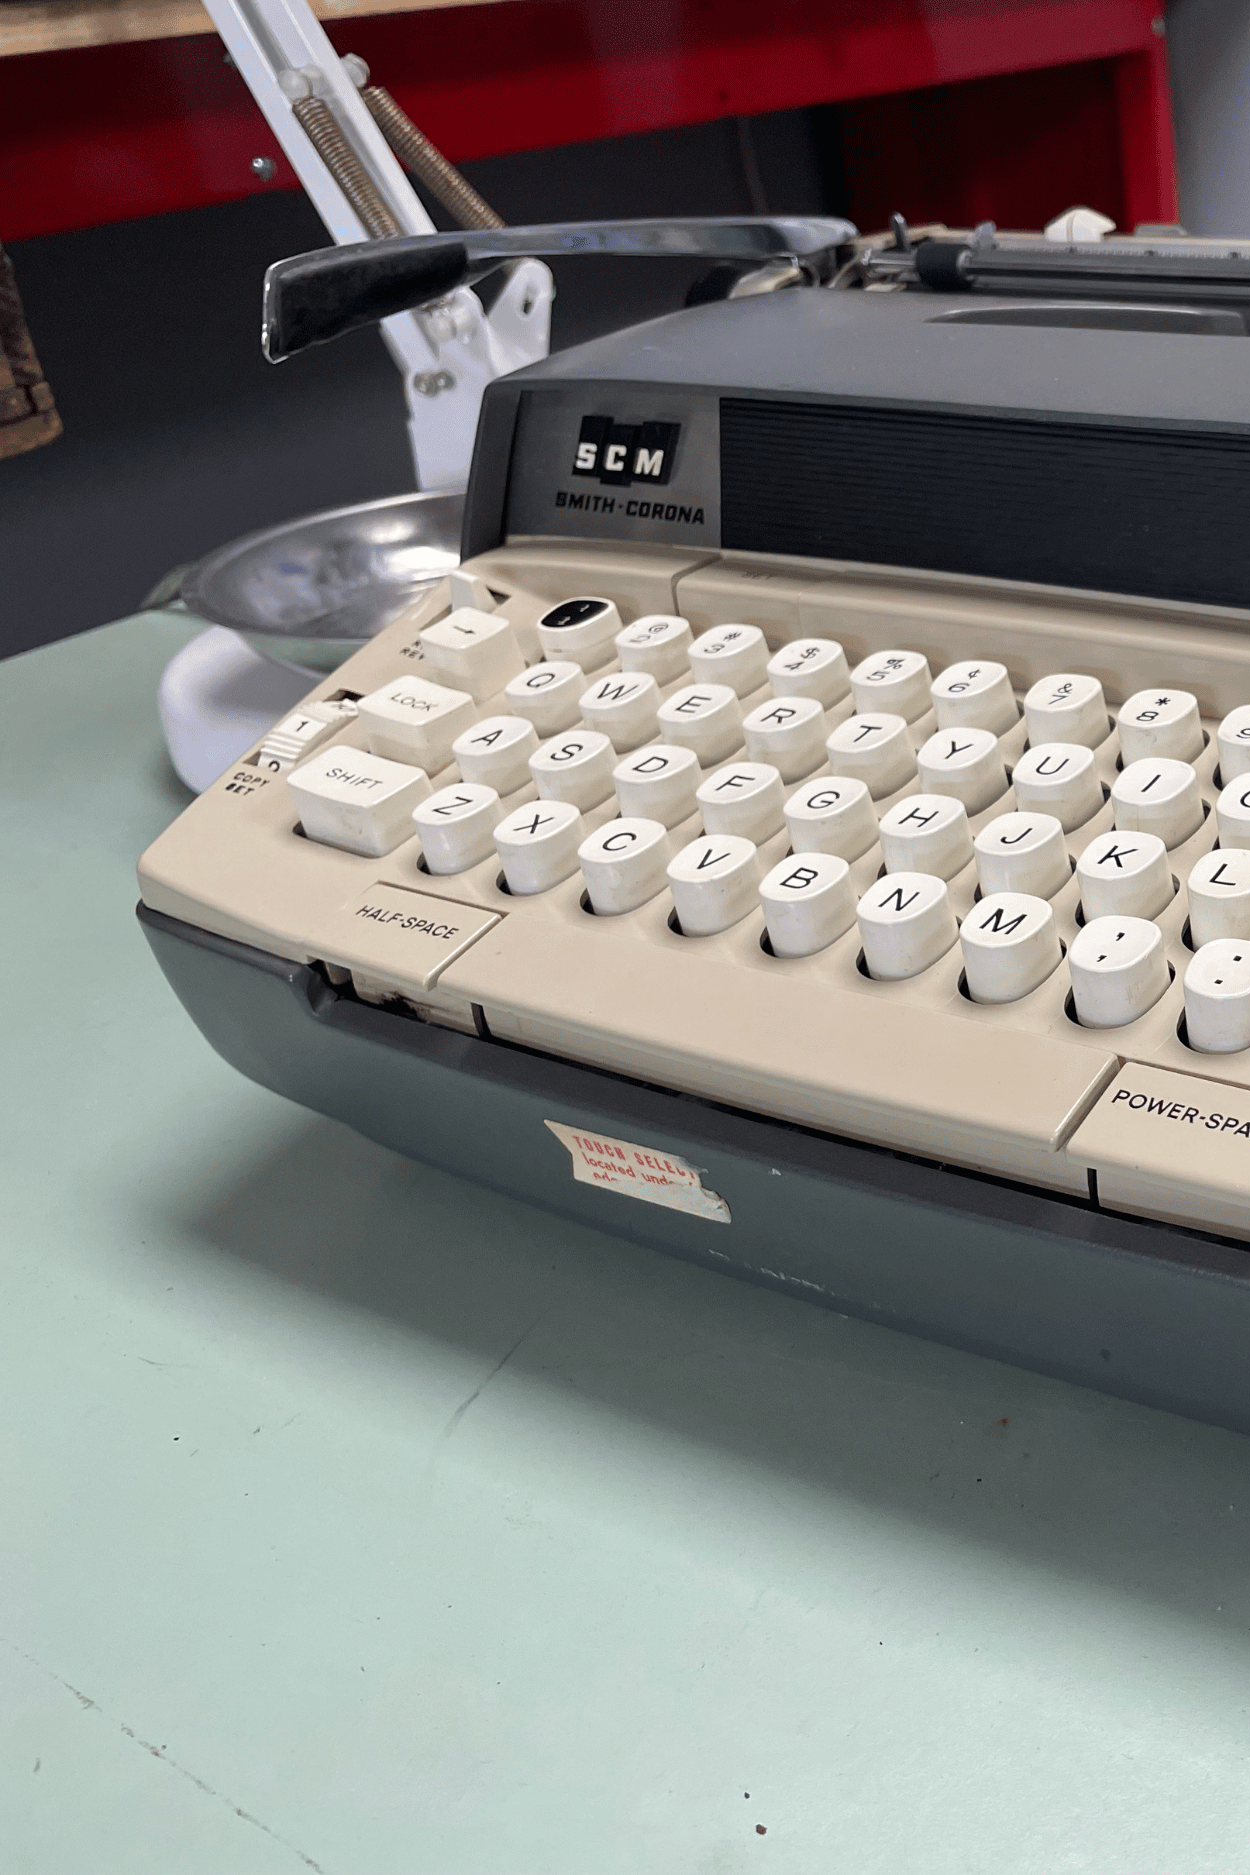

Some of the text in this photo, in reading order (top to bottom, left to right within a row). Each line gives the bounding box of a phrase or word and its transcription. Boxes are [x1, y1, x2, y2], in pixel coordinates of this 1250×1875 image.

[575, 442, 664, 476] SCM
[648, 624, 669, 633] @
[629, 634, 651, 644] 2
[703, 644, 726, 654] 3
[800, 647, 820, 659] $
[783, 661, 804, 671] 4
[885, 657, 905, 671] %
[526, 672, 556, 689] Q
[866, 670, 886, 680] 5
[967, 668, 982, 680] ¢
[597, 682, 638, 701] W
[947, 682, 970, 693] 6
[1058, 681, 1074, 696] &
[390, 692, 438, 712] LOCK
[675, 695, 711, 714] E
[1048, 694, 1068, 705] 7
[760, 707, 797, 724] R
[1135, 711, 1159, 722] 8
[296, 721, 309, 732] 1
[853, 724, 882, 743] T
[472, 728, 503, 748] A
[550, 743, 584, 761] S
[945, 740, 972, 760] Y
[632, 756, 669, 773] D
[1035, 756, 1070, 776] U
[232, 771, 271, 788] COPY
[325, 768, 383, 789] SHIFT
[715, 774, 755, 791] F
[1141, 774, 1161, 793] I
[432, 796, 473, 816] Z
[806, 790, 841, 809] G
[514, 814, 554, 835] X
[898, 807, 939, 828] H
[602, 832, 637, 852] C
[1000, 827, 1033, 845] J
[696, 848, 731, 870] V
[1097, 845, 1138, 868] K
[779, 867, 819, 889] B
[1209, 863, 1236, 886] L
[878, 887, 920, 912] N
[355, 904, 460, 940] HALF-SPACE
[979, 907, 1028, 935] M
[582, 1151, 637, 1179] located
